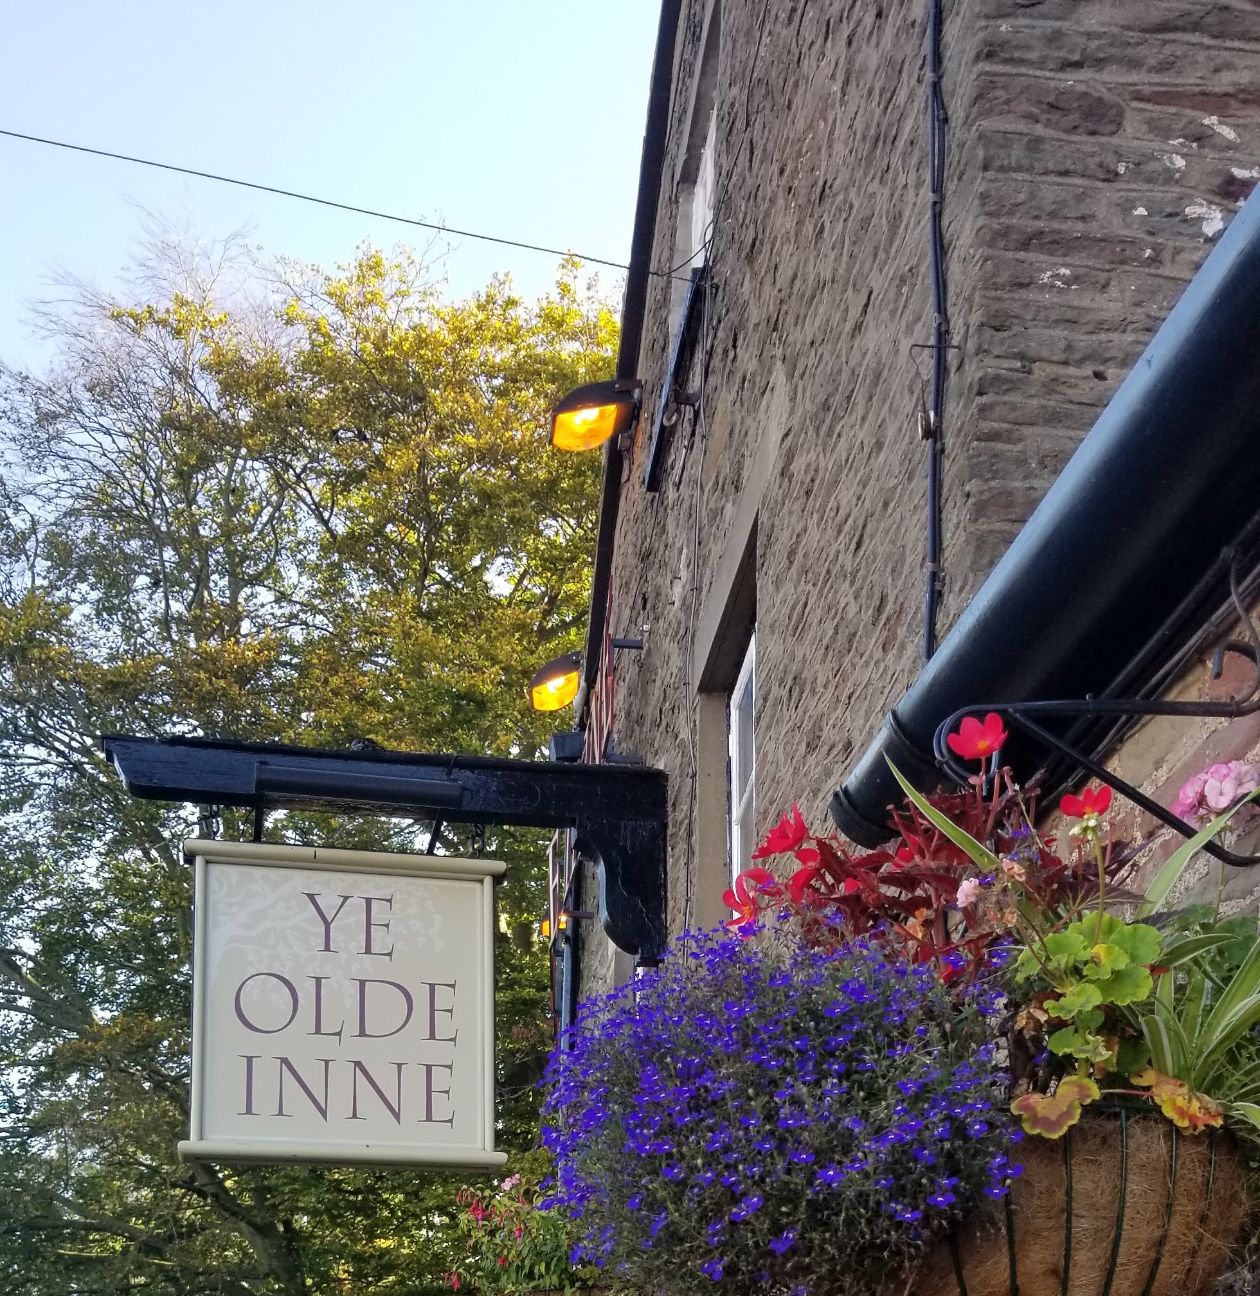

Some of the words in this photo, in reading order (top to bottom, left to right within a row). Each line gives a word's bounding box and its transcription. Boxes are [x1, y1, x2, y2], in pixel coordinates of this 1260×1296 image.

[301, 892, 394, 962] YE
[234, 972, 459, 1048] OLDE
[236, 1054, 456, 1129] INNE
